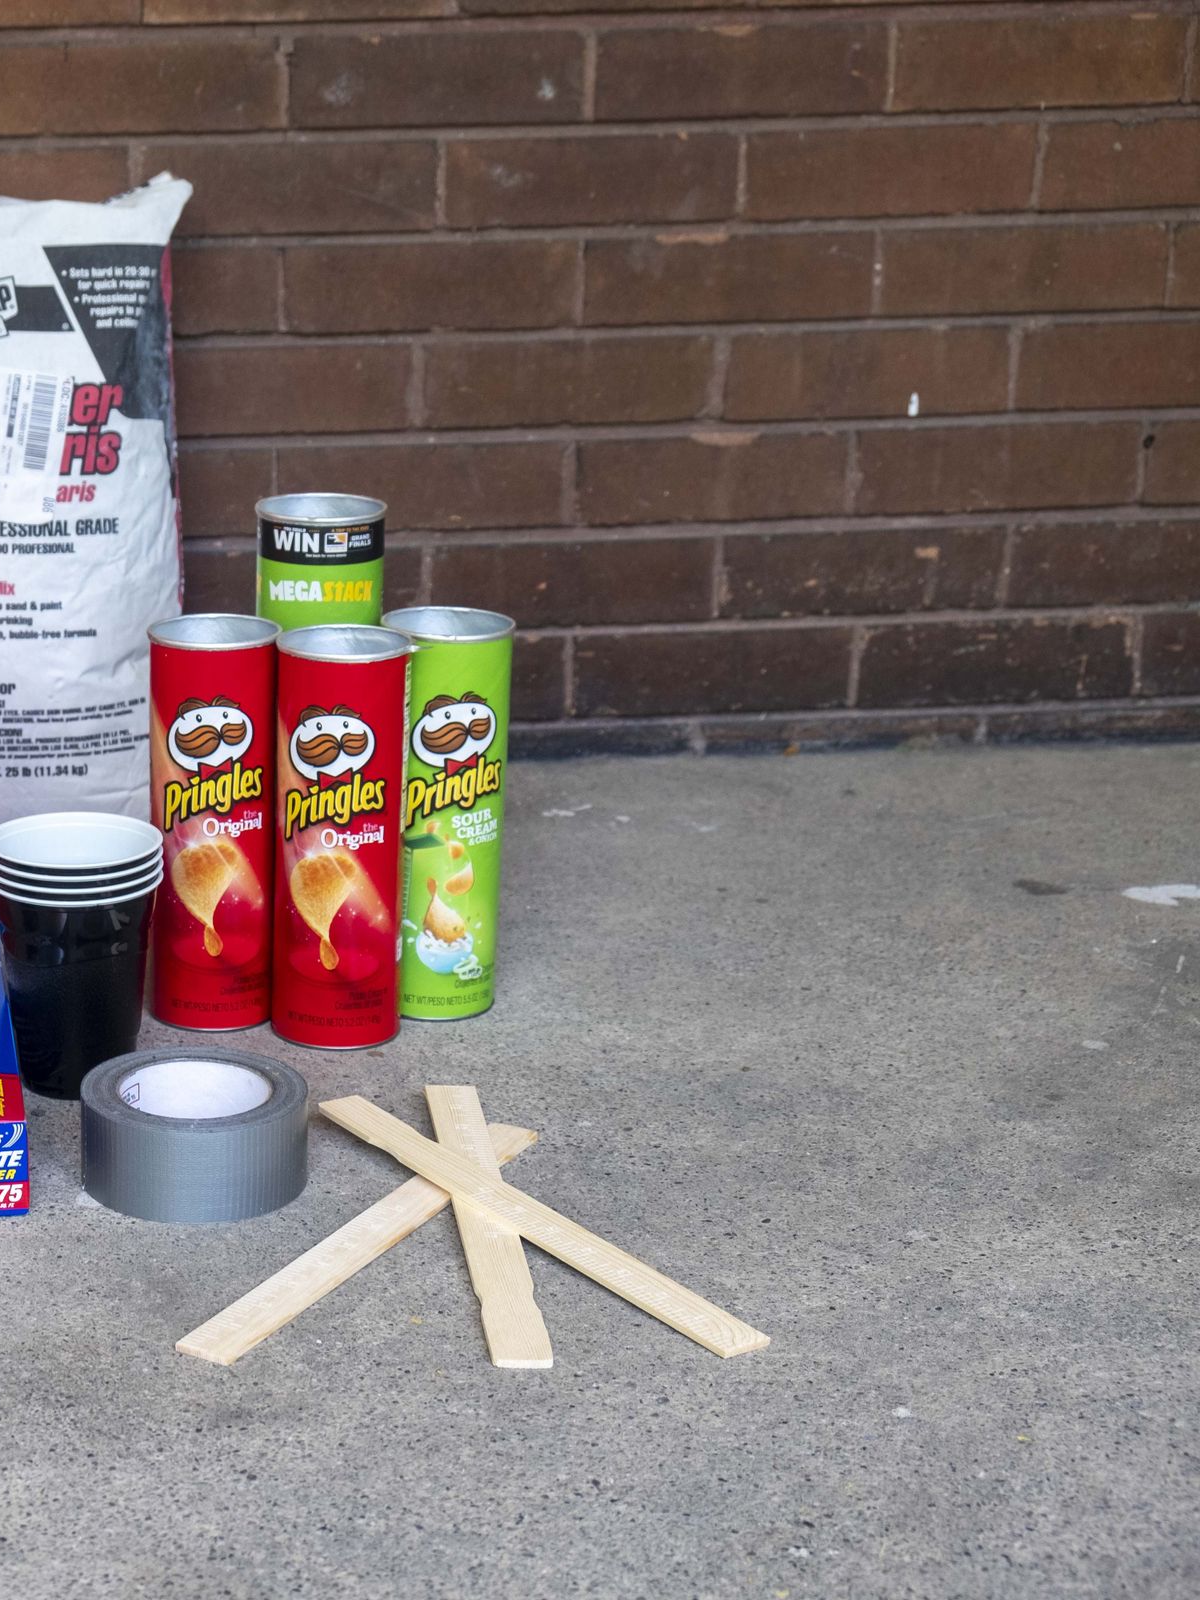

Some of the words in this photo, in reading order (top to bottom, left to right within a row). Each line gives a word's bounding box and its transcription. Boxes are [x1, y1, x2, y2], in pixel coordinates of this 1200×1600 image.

[91, 266, 112, 278] hard
[75, 517, 119, 536] GRADE
[12, 542, 76, 554] PROFESIONAL
[273, 529, 320, 553] WIN
[349, 540, 371, 548] FINALS
[6, 601, 27, 611] sand
[30, 601, 38, 610] &
[40, 601, 62, 612] paint
[6, 766, 19, 777] 25
[22, 766, 31, 776] lb
[34, 765, 68, 778] (11.34
[72, 763, 88, 776] kg)
[164, 762, 263, 832] Pringles
[406, 760, 502, 829] Pringles
[285, 771, 387, 840] Pringles
[202, 812, 263, 840] Original
[362, 822, 378, 832] the
[452, 808, 492, 828] SOUR
[456, 818, 498, 838] CREAM
[320, 826, 384, 850] Original
